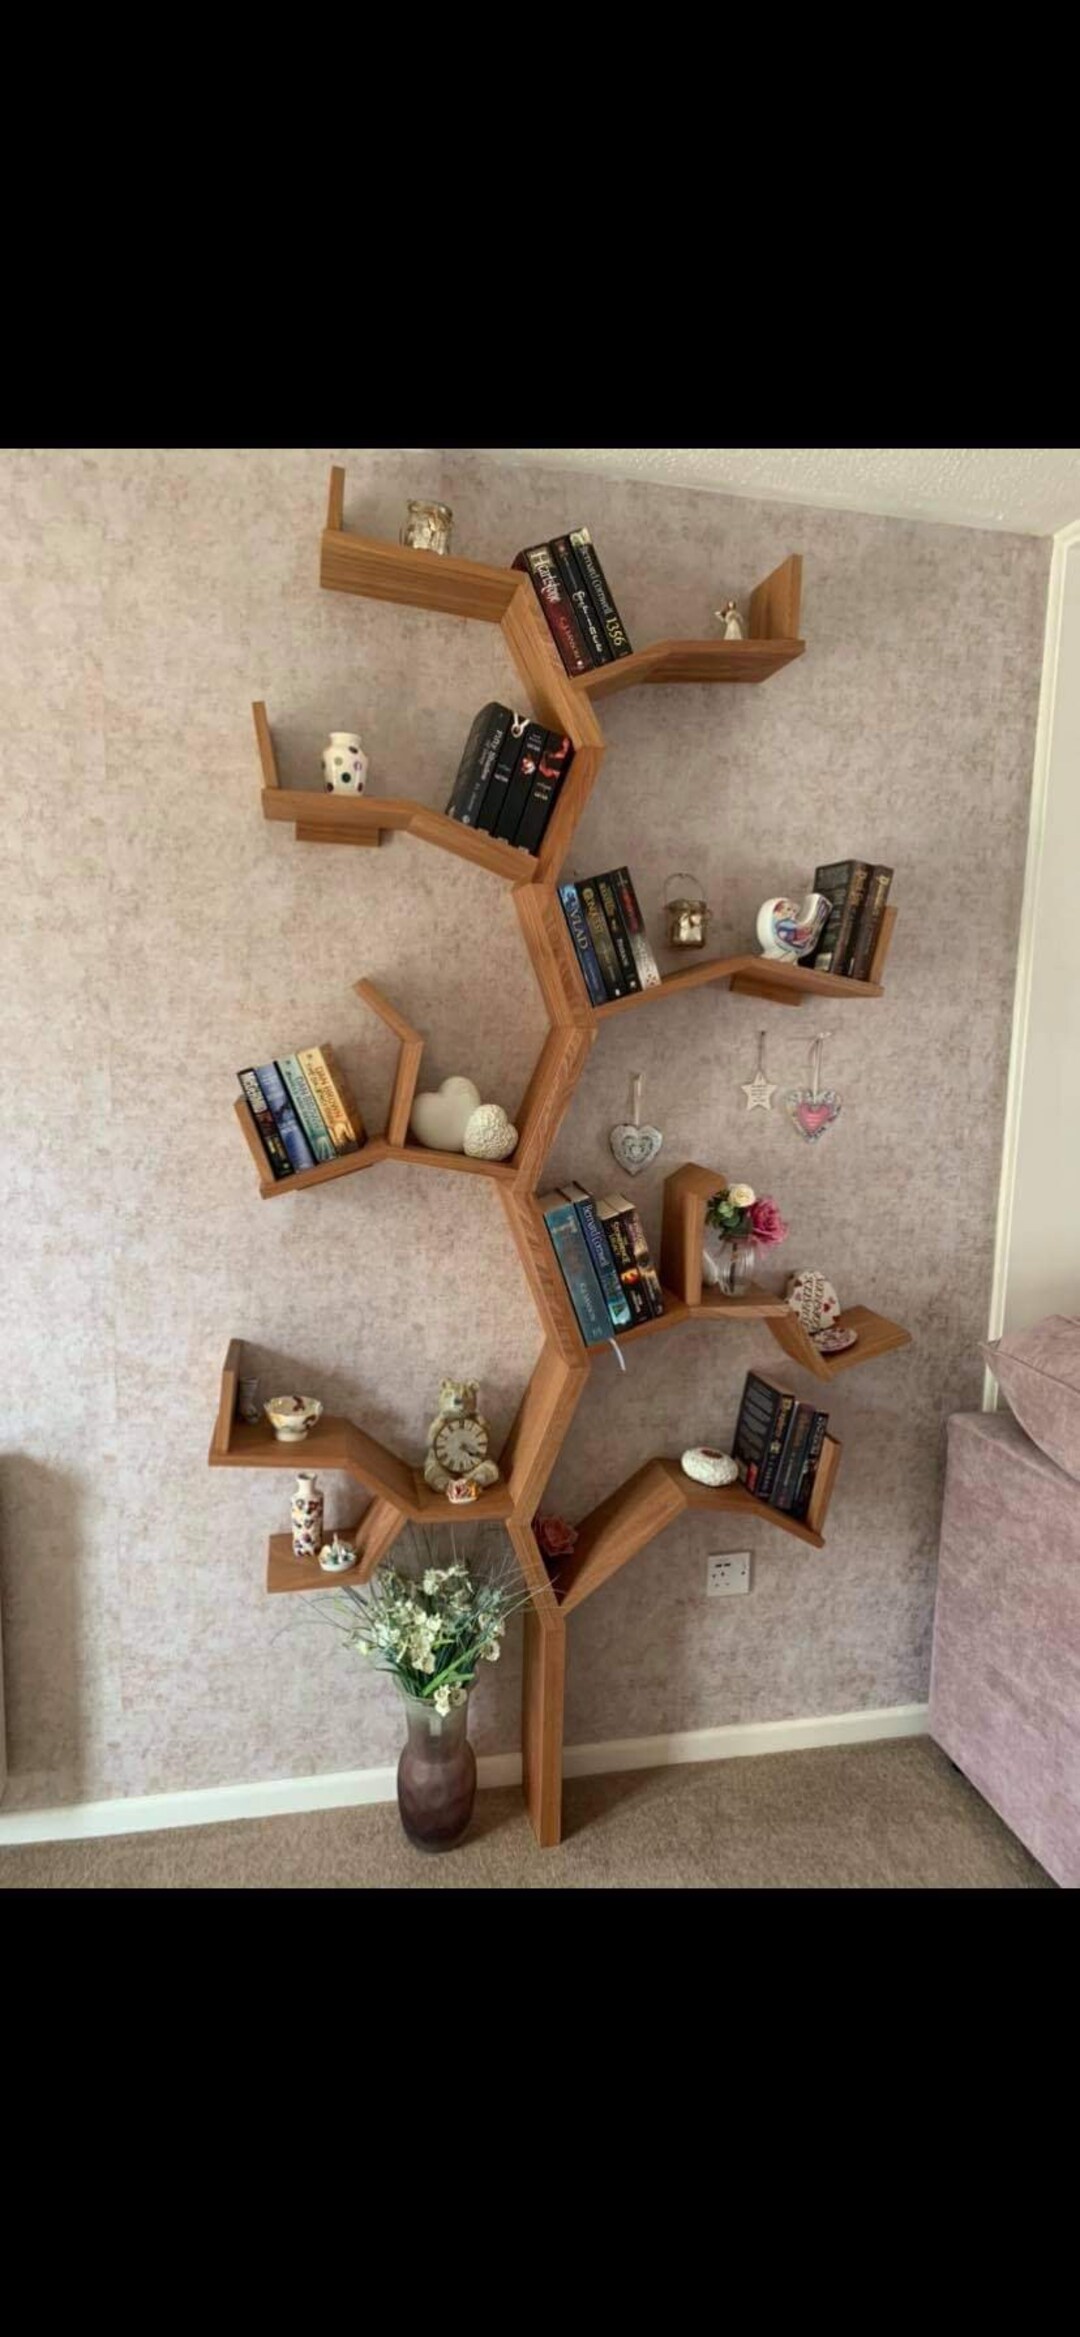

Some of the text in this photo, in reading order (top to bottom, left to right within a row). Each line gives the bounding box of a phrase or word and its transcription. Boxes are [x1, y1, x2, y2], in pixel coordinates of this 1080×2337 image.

[527, 548, 565, 606] Heartstone
[604, 616, 625, 647] 1356
[479, 729, 502, 781] Fifty Shades
[567, 906, 589, 950] VLAD
[313, 1065, 342, 1119] DAN BROWN
[580, 1203, 602, 1236] Bernard
